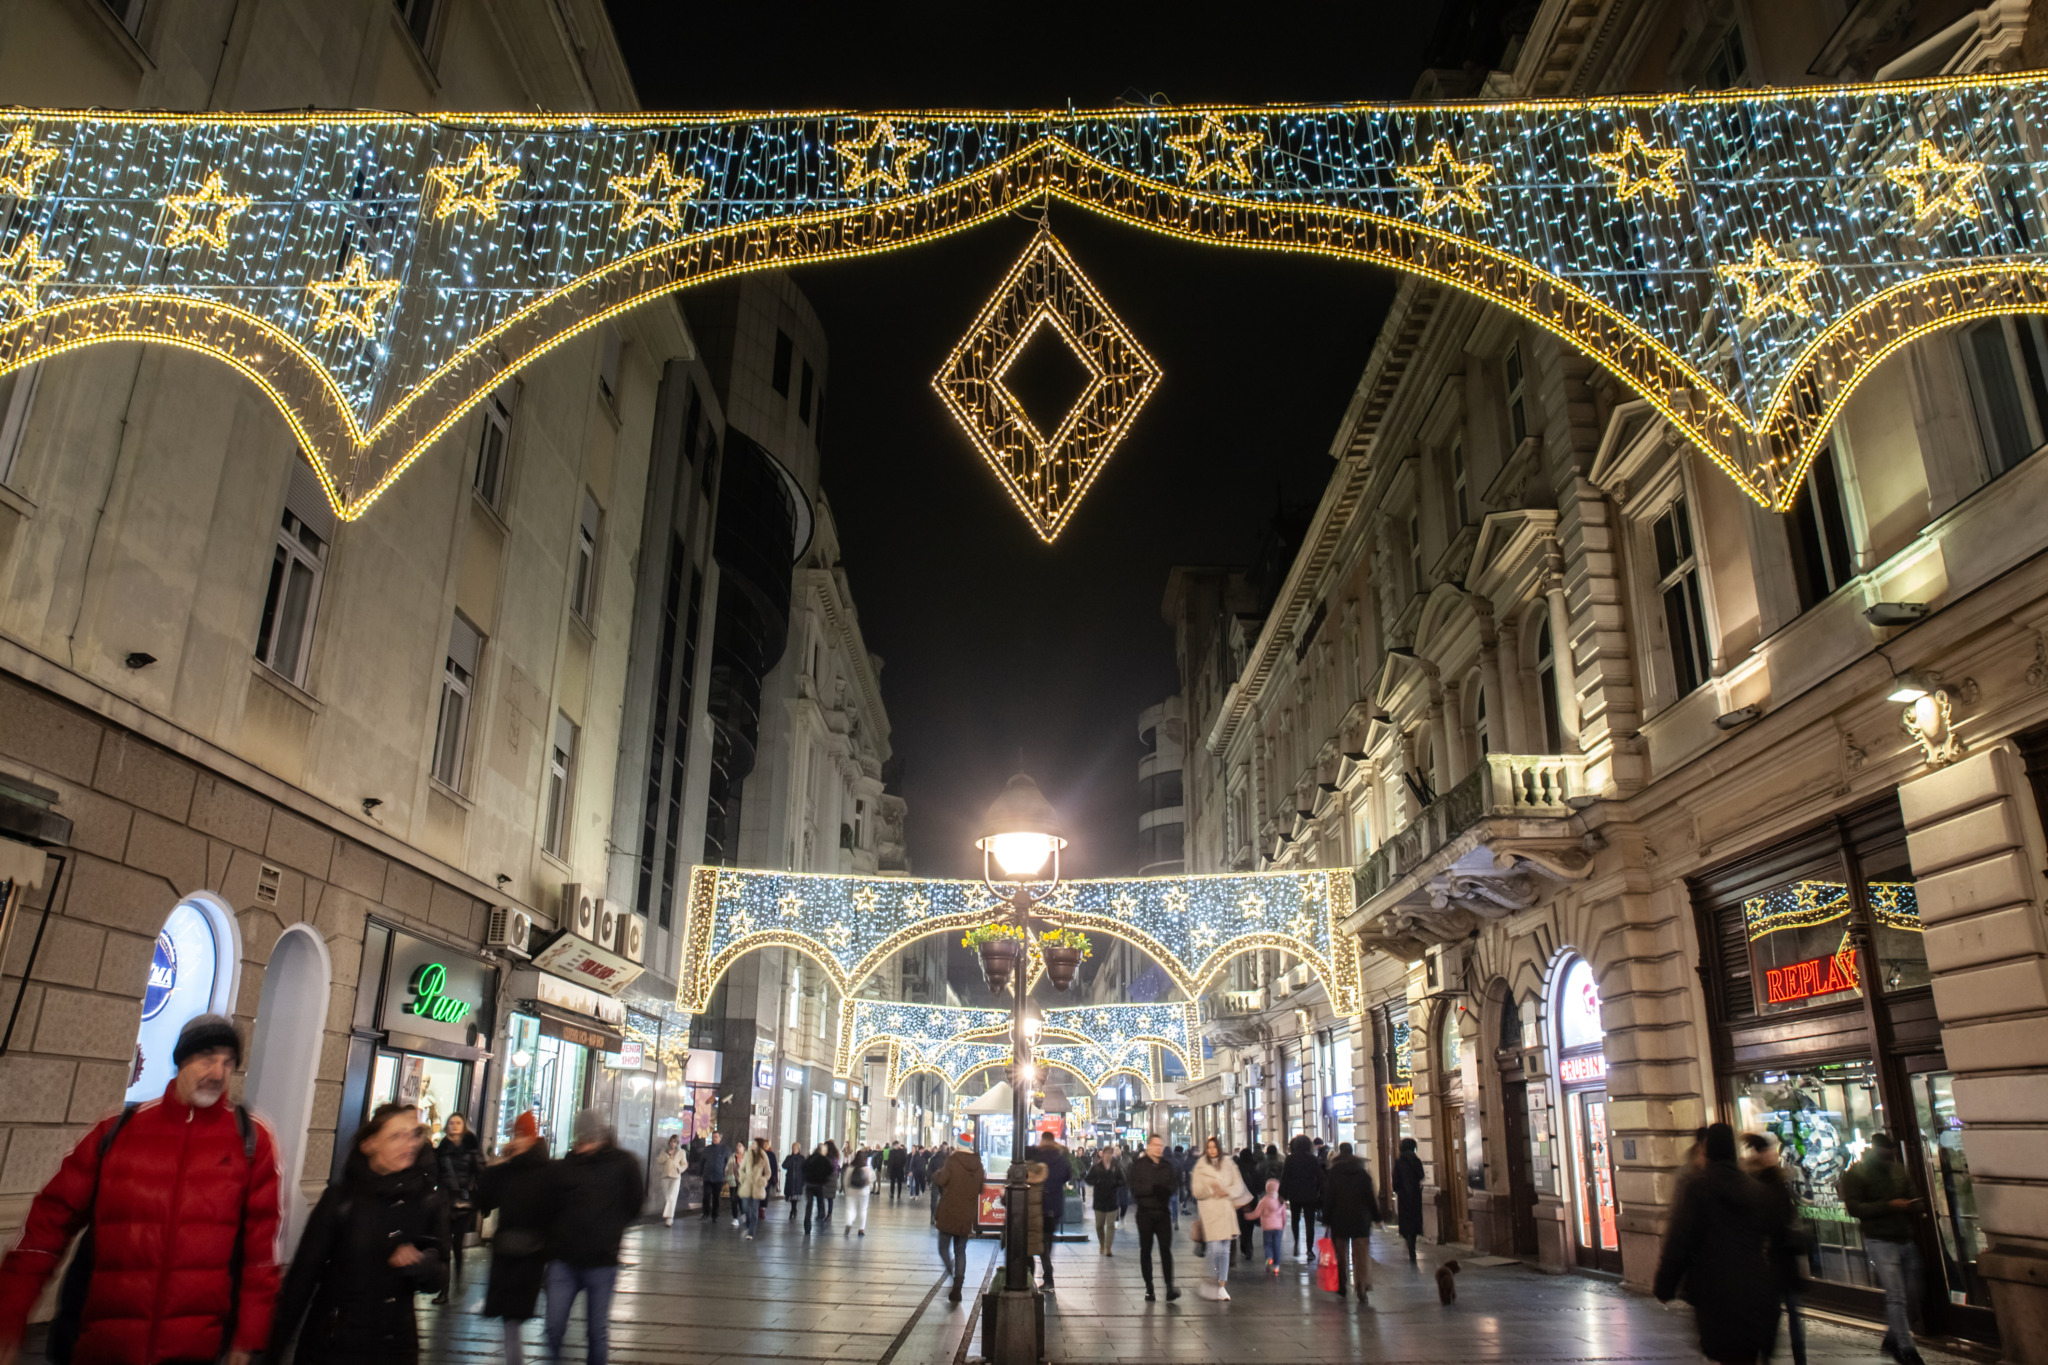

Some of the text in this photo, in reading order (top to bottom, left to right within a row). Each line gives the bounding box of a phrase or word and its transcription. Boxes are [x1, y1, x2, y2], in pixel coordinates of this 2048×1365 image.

[413, 962, 471, 1024] Paar
[1766, 950, 1857, 1003] REPLAY
[1560, 1056, 1601, 1080] GRUBIN
